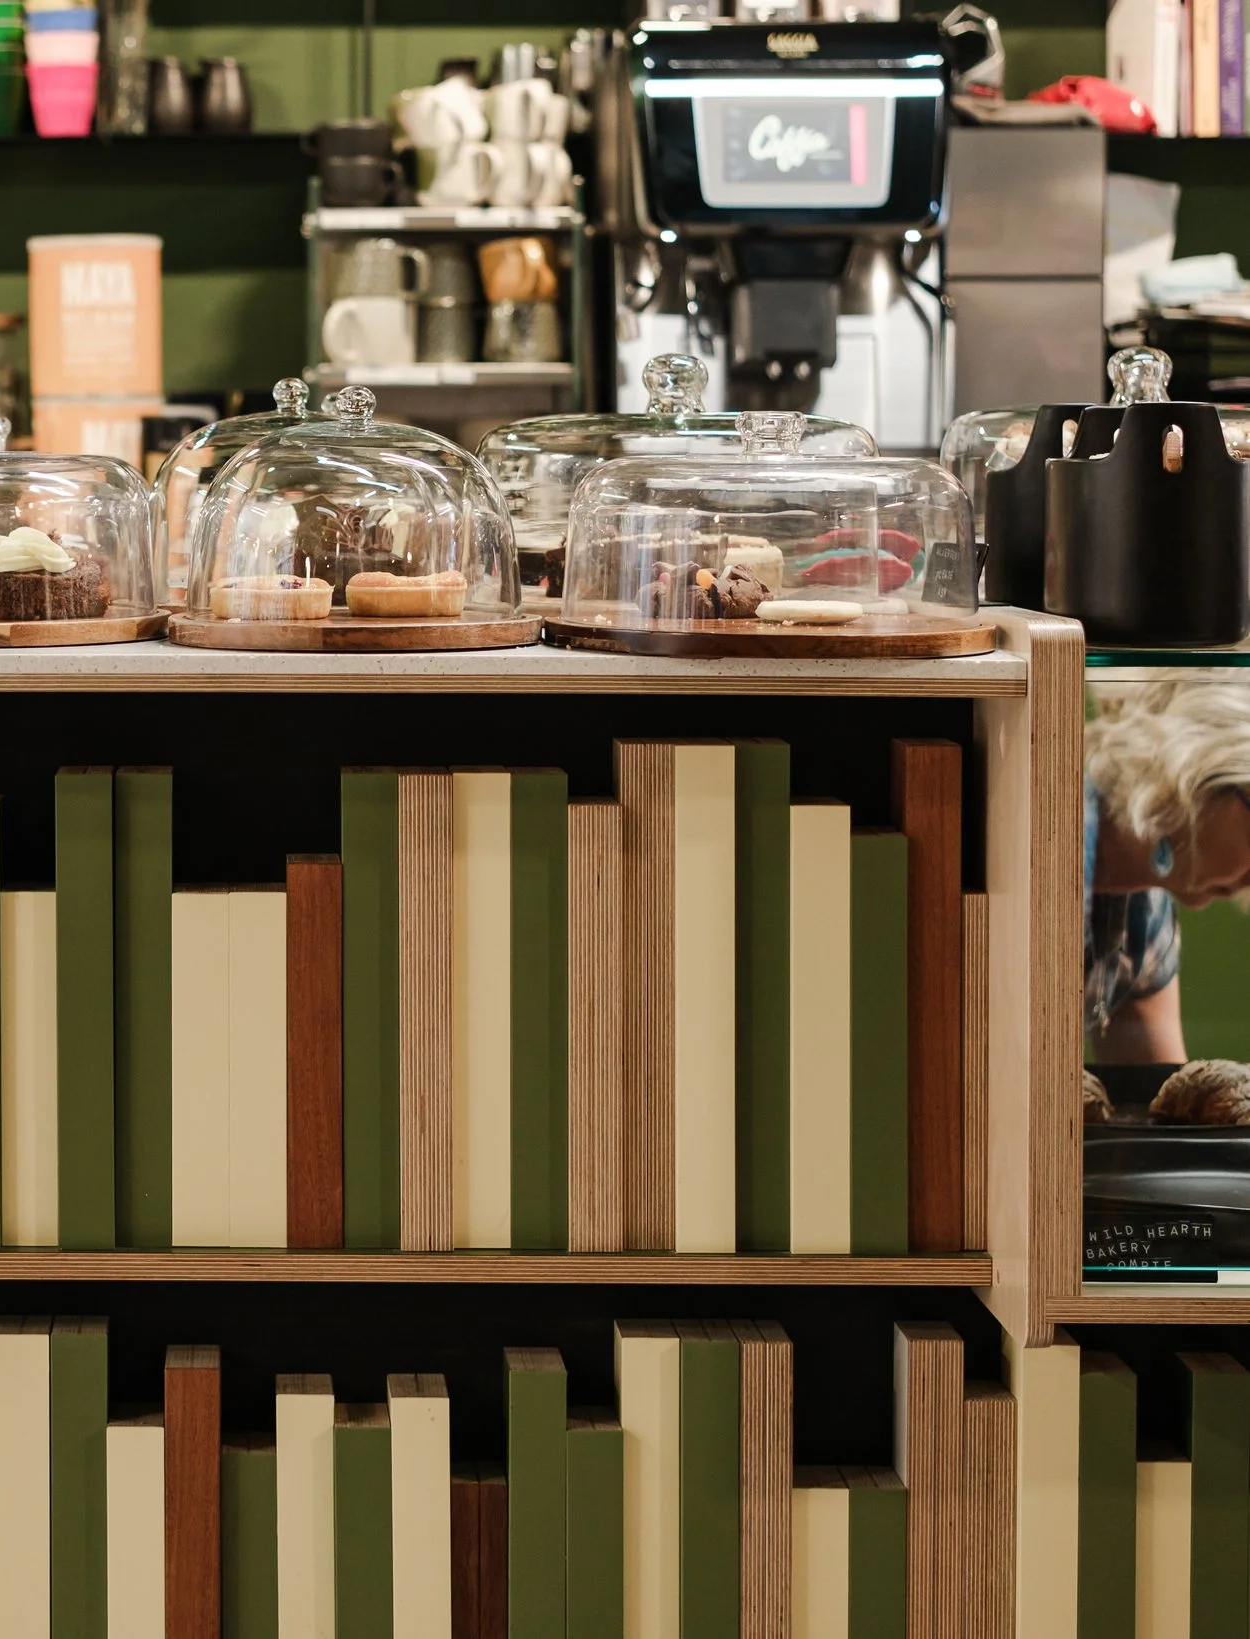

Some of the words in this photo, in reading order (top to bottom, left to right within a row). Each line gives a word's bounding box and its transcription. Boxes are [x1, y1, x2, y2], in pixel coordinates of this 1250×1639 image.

[1088, 1225, 1134, 1242] WILD
[1146, 1223, 1212, 1238] HEARTH
[1086, 1242, 1151, 1259] BAKERY
